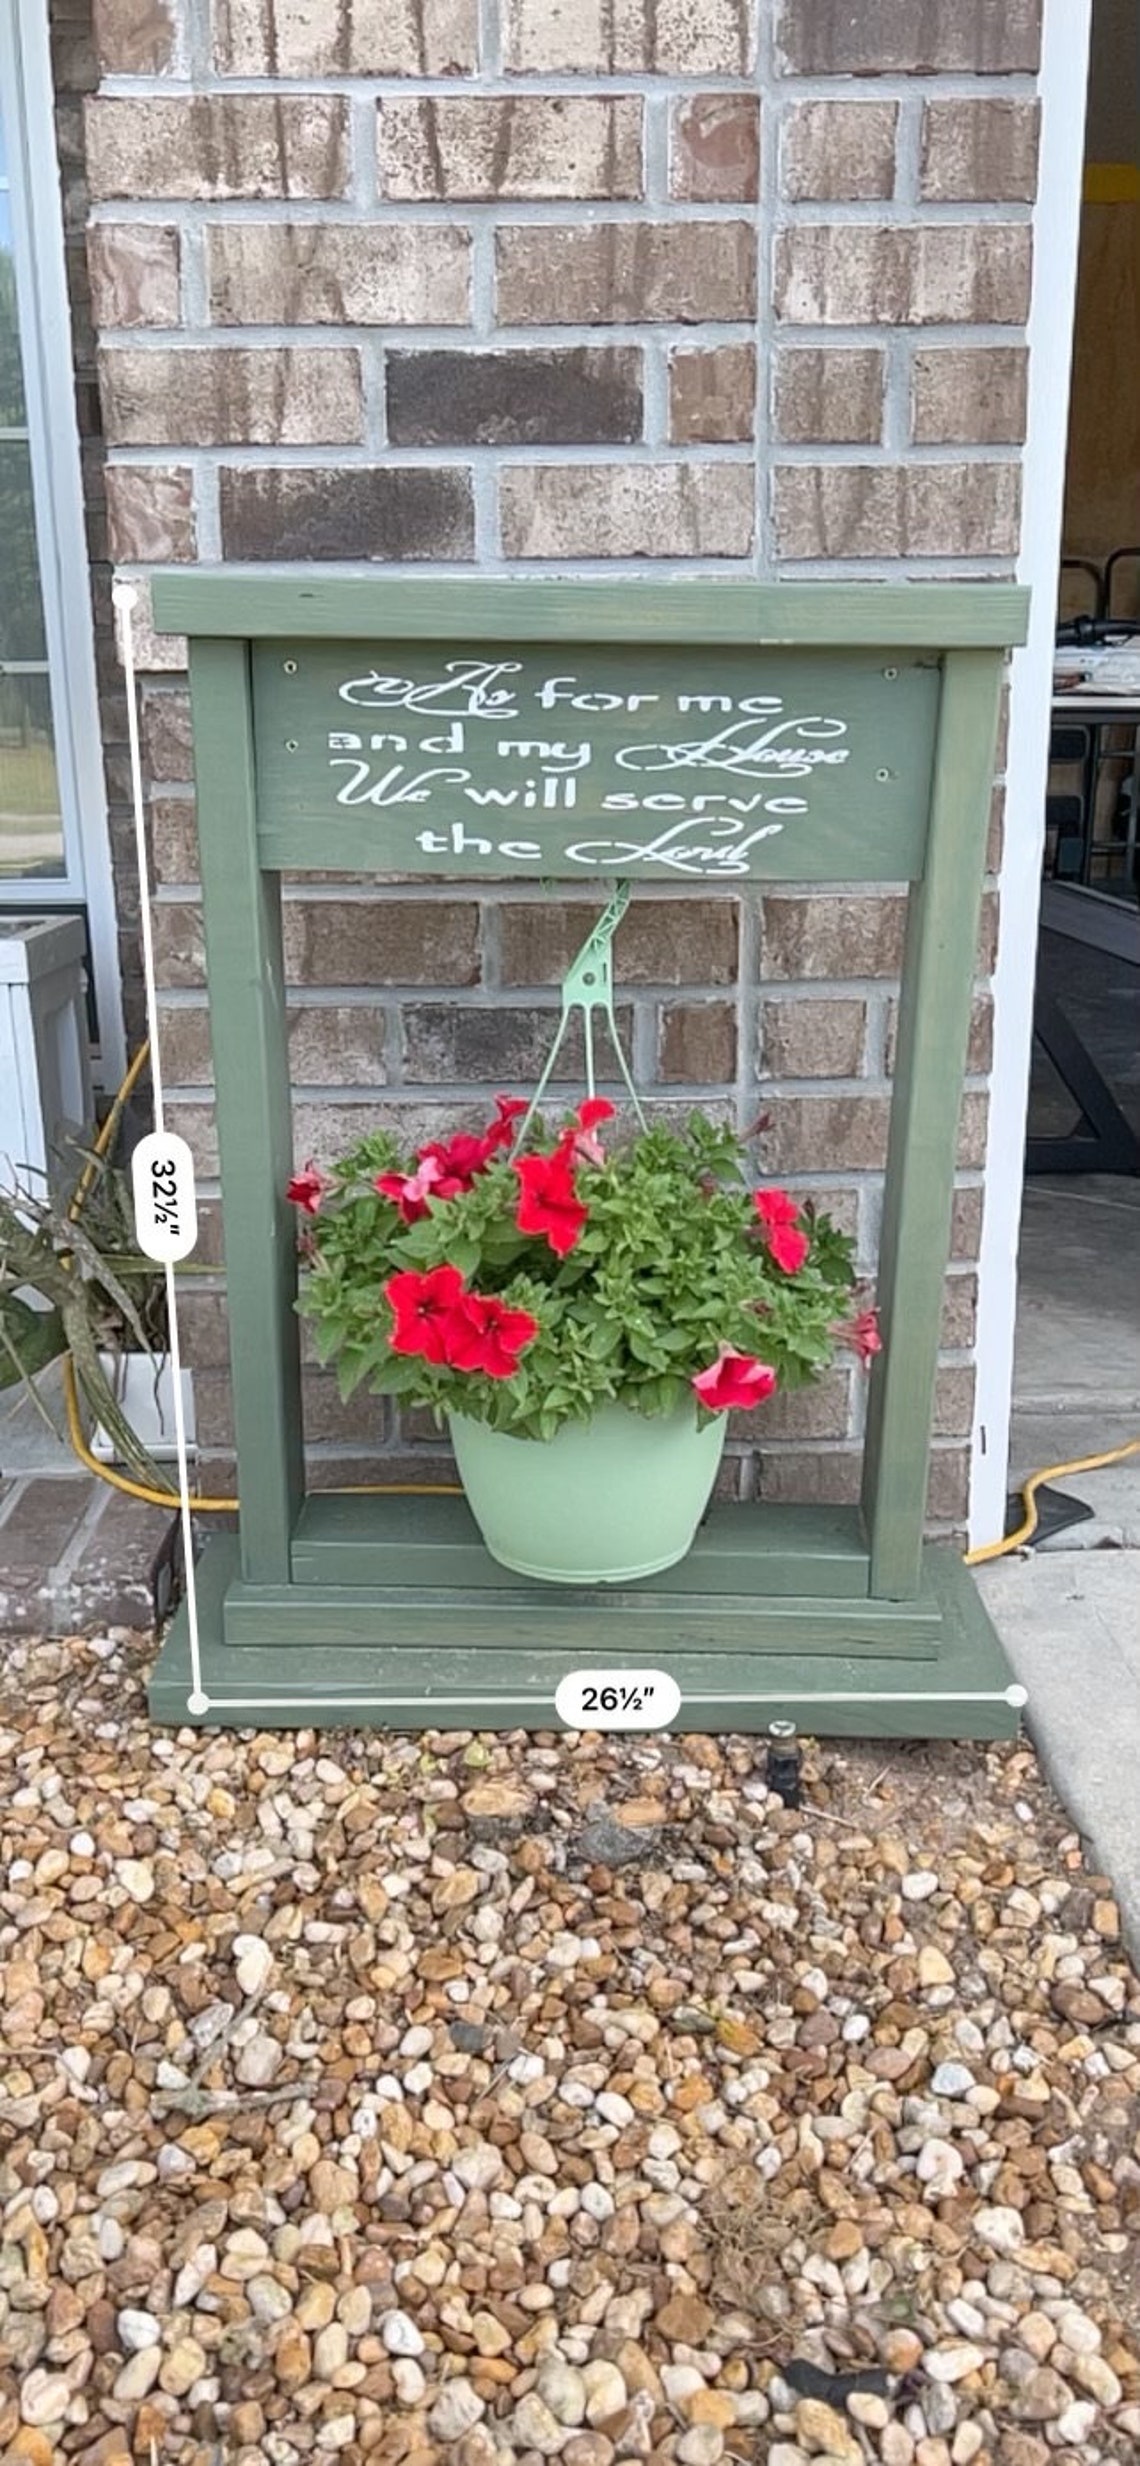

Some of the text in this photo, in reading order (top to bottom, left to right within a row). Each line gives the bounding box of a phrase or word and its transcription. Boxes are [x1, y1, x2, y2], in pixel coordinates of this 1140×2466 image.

[338, 661, 784, 718] As for me
[328, 717, 850, 778] and my House
[329, 759, 809, 814] We will serve
[415, 817, 784, 875] the Lord
